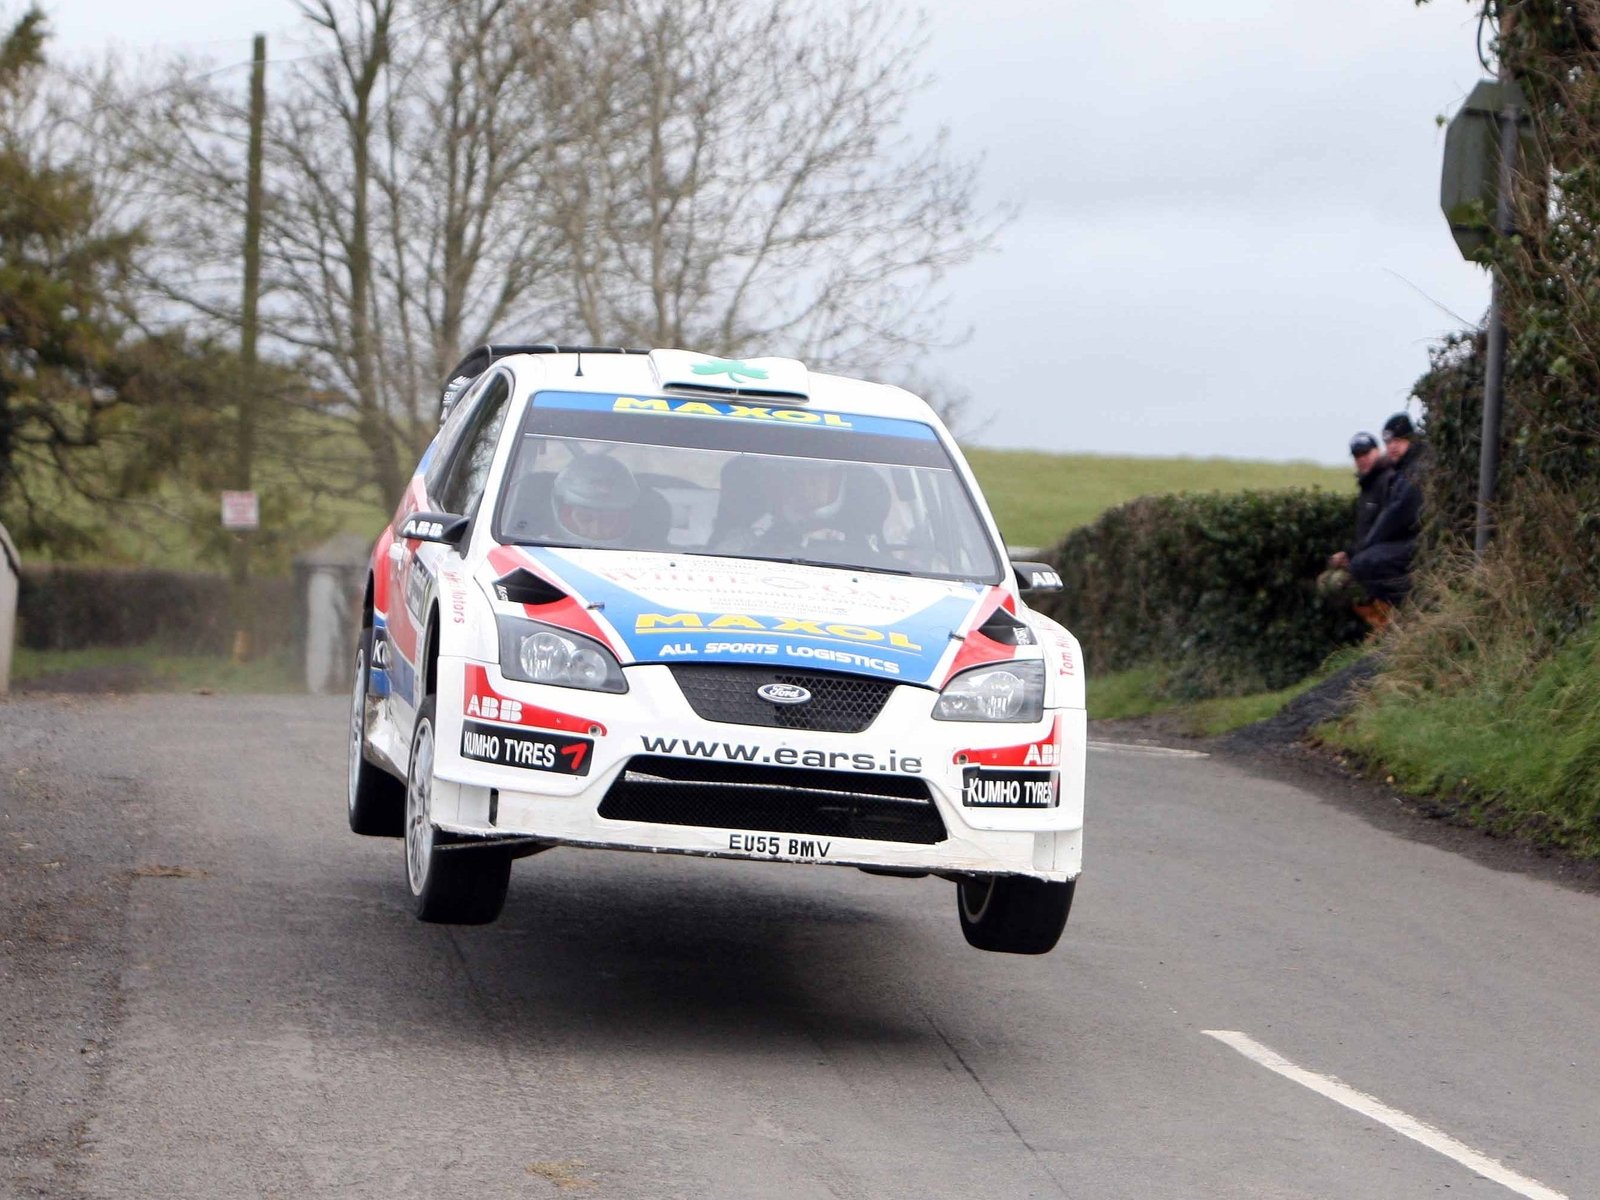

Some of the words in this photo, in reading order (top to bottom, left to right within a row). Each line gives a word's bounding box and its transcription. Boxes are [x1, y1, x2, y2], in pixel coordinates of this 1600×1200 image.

[612, 396, 853, 429] MAXOL
[402, 519, 444, 538] ABB
[635, 613, 922, 651] MAXOL
[658, 643, 698, 657] ALL
[704, 642, 779, 656] SPORTS
[786, 644, 901, 674] LOGISTICS
[768, 684, 800, 699] Ford
[466, 694, 523, 722] ABB
[463, 730, 500, 758] KUMHO
[504, 738, 556, 767] TYRES
[639, 735, 923, 774] www.ears.ie
[967, 777, 1021, 803] KUMHO
[1024, 781, 1053, 804] TYRES
[729, 834, 781, 856] EU55
[788, 838, 832, 858] BMV
